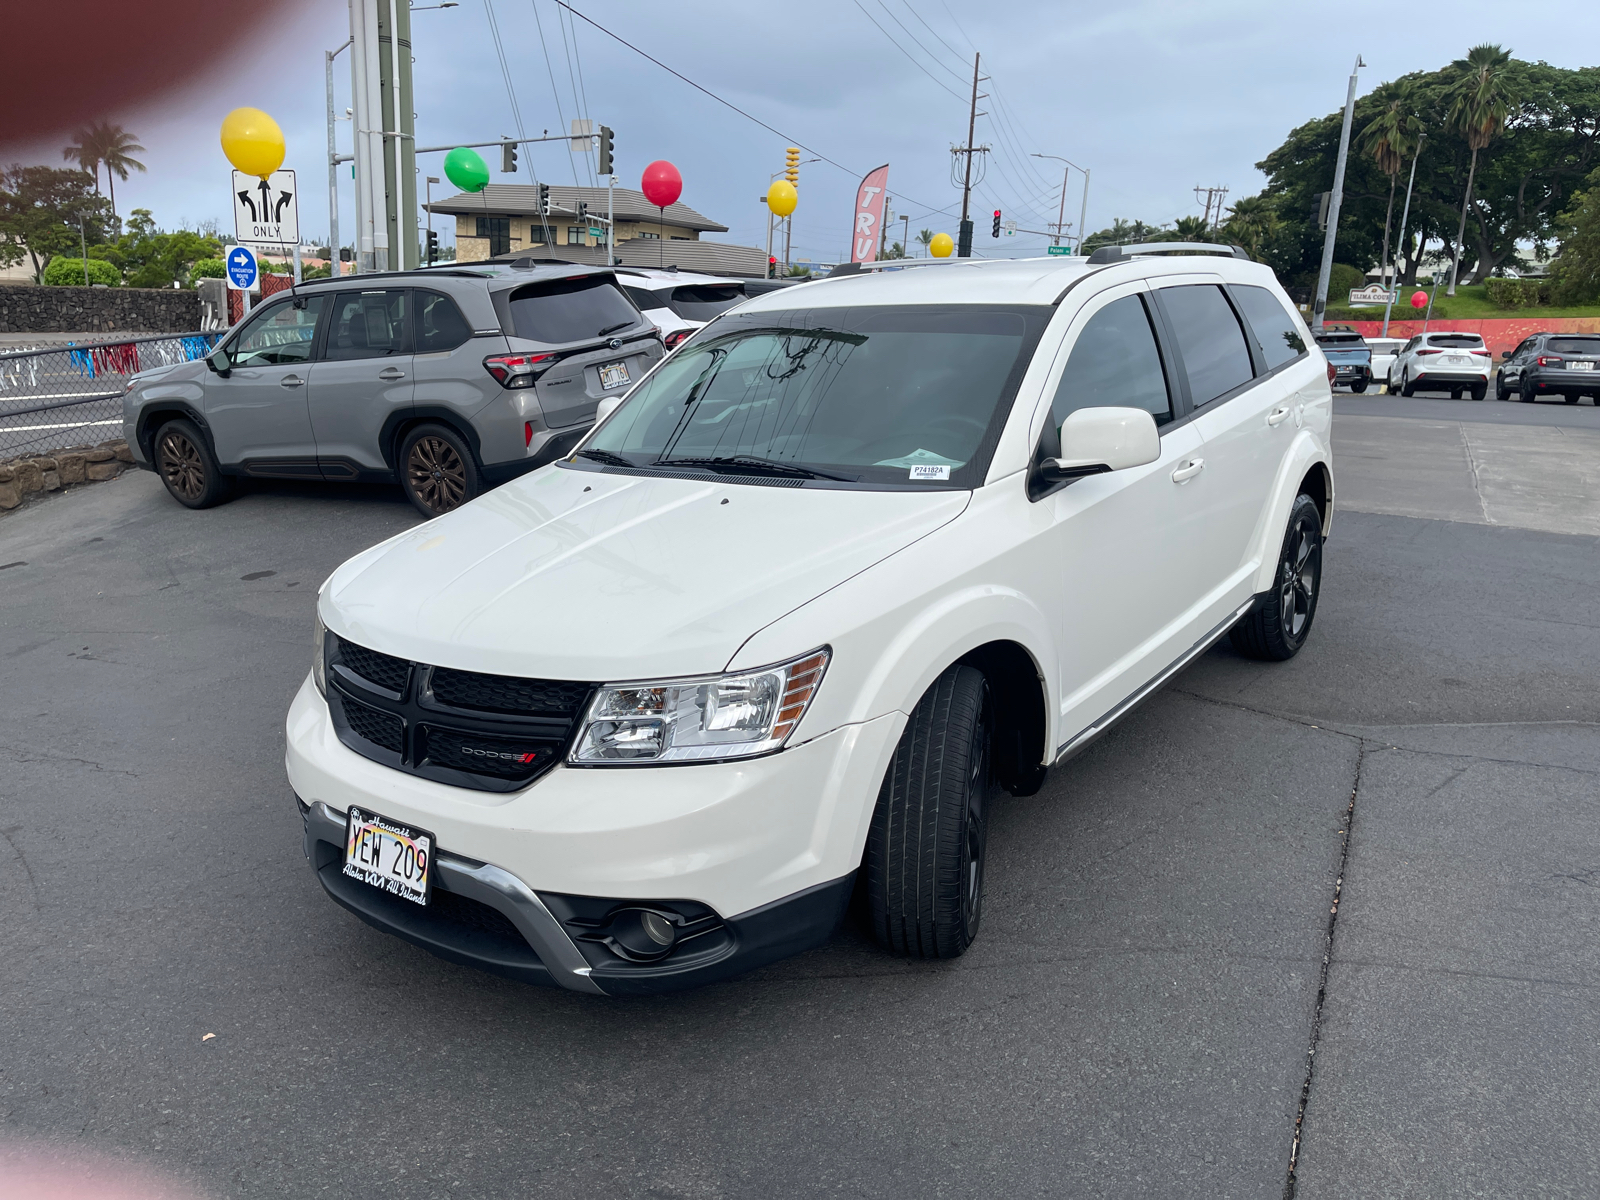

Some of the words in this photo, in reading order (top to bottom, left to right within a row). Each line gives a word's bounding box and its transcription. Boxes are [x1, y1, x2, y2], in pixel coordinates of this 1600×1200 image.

[253, 225, 280, 238] ONLY
[547, 379, 573, 387] SUBARU
[914, 466, 944, 475] P74182A
[461, 746, 526, 761] DODGE
[368, 816, 410, 837] Hawaii
[353, 824, 382, 868] YEW
[392, 840, 427, 882] 209
[342, 863, 364, 881] Aloha
[386, 880, 398, 895] All
[398, 884, 427, 906] Islands
